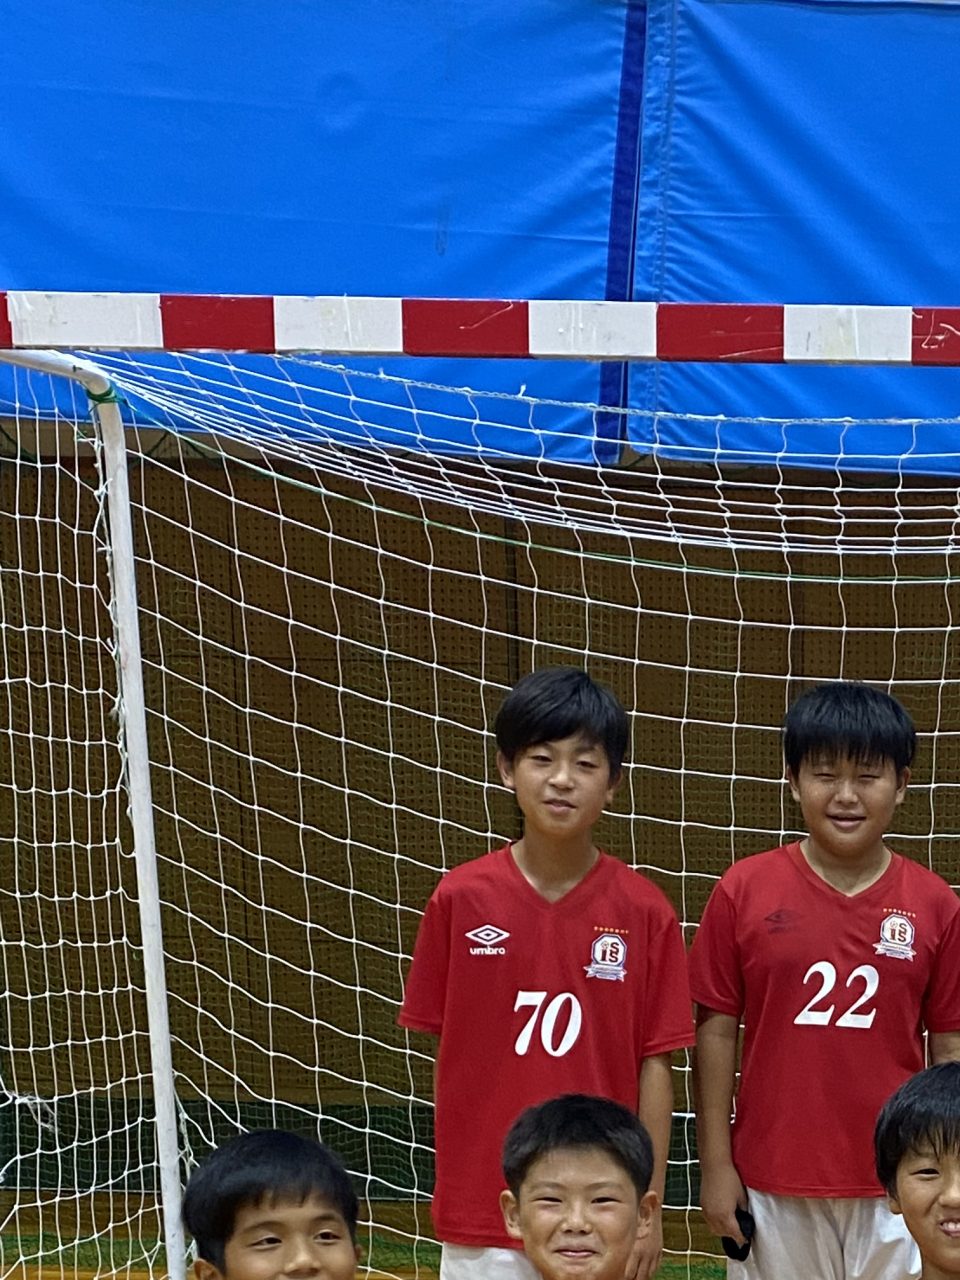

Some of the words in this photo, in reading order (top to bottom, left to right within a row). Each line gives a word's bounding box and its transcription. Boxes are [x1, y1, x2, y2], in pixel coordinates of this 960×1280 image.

[470, 945, 506, 956] umbro
[514, 990, 582, 1057] 70
[794, 961, 879, 1029] 22
